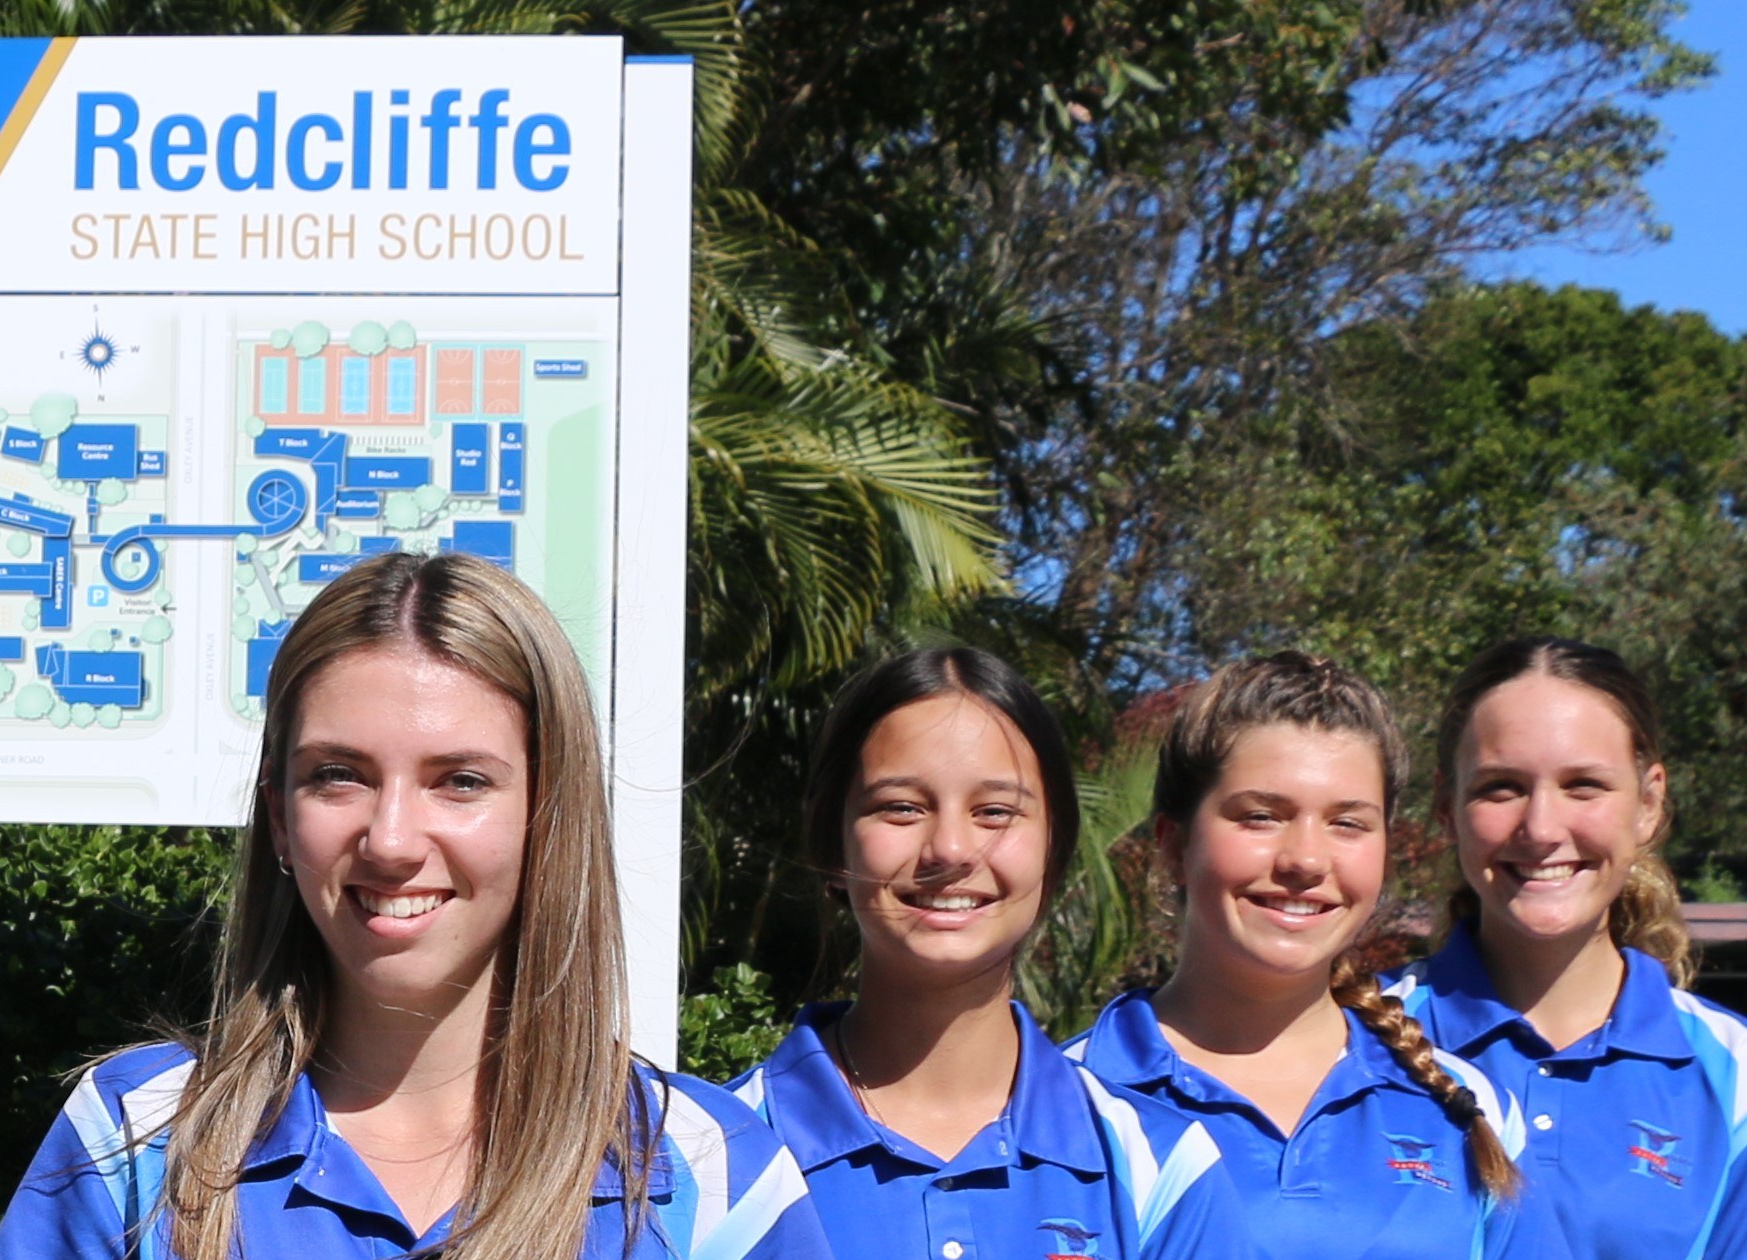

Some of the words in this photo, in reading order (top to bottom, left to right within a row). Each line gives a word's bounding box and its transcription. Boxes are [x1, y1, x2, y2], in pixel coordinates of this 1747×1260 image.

[74, 88, 573, 191] Redcliffe
[69, 213, 218, 261] STATE
[239, 213, 357, 261] HIGH
[377, 213, 585, 261] SCHOOL
[536, 363, 560, 373] Sports
[561, 363, 582, 372] Shed
[15, 439, 38, 449] Block
[77, 442, 114, 452] Resource
[285, 437, 308, 448] Block
[500, 442, 522, 450] Block
[81, 451, 109, 460] Centre
[142, 453, 158, 461] Bus
[455, 448, 482, 458] Studio
[140, 461, 161, 470] Shed
[377, 470, 399, 480] Block
[499, 488, 521, 496] Block
[335, 500, 380, 508] Auditorium
[8, 509, 30, 522] Block
[54, 583, 64, 610] Centre
[123, 598, 152, 606] Visitor
[118, 607, 156, 616] Entrance
[92, 673, 115, 684] Block
[18, 755, 45, 765] ROAD
